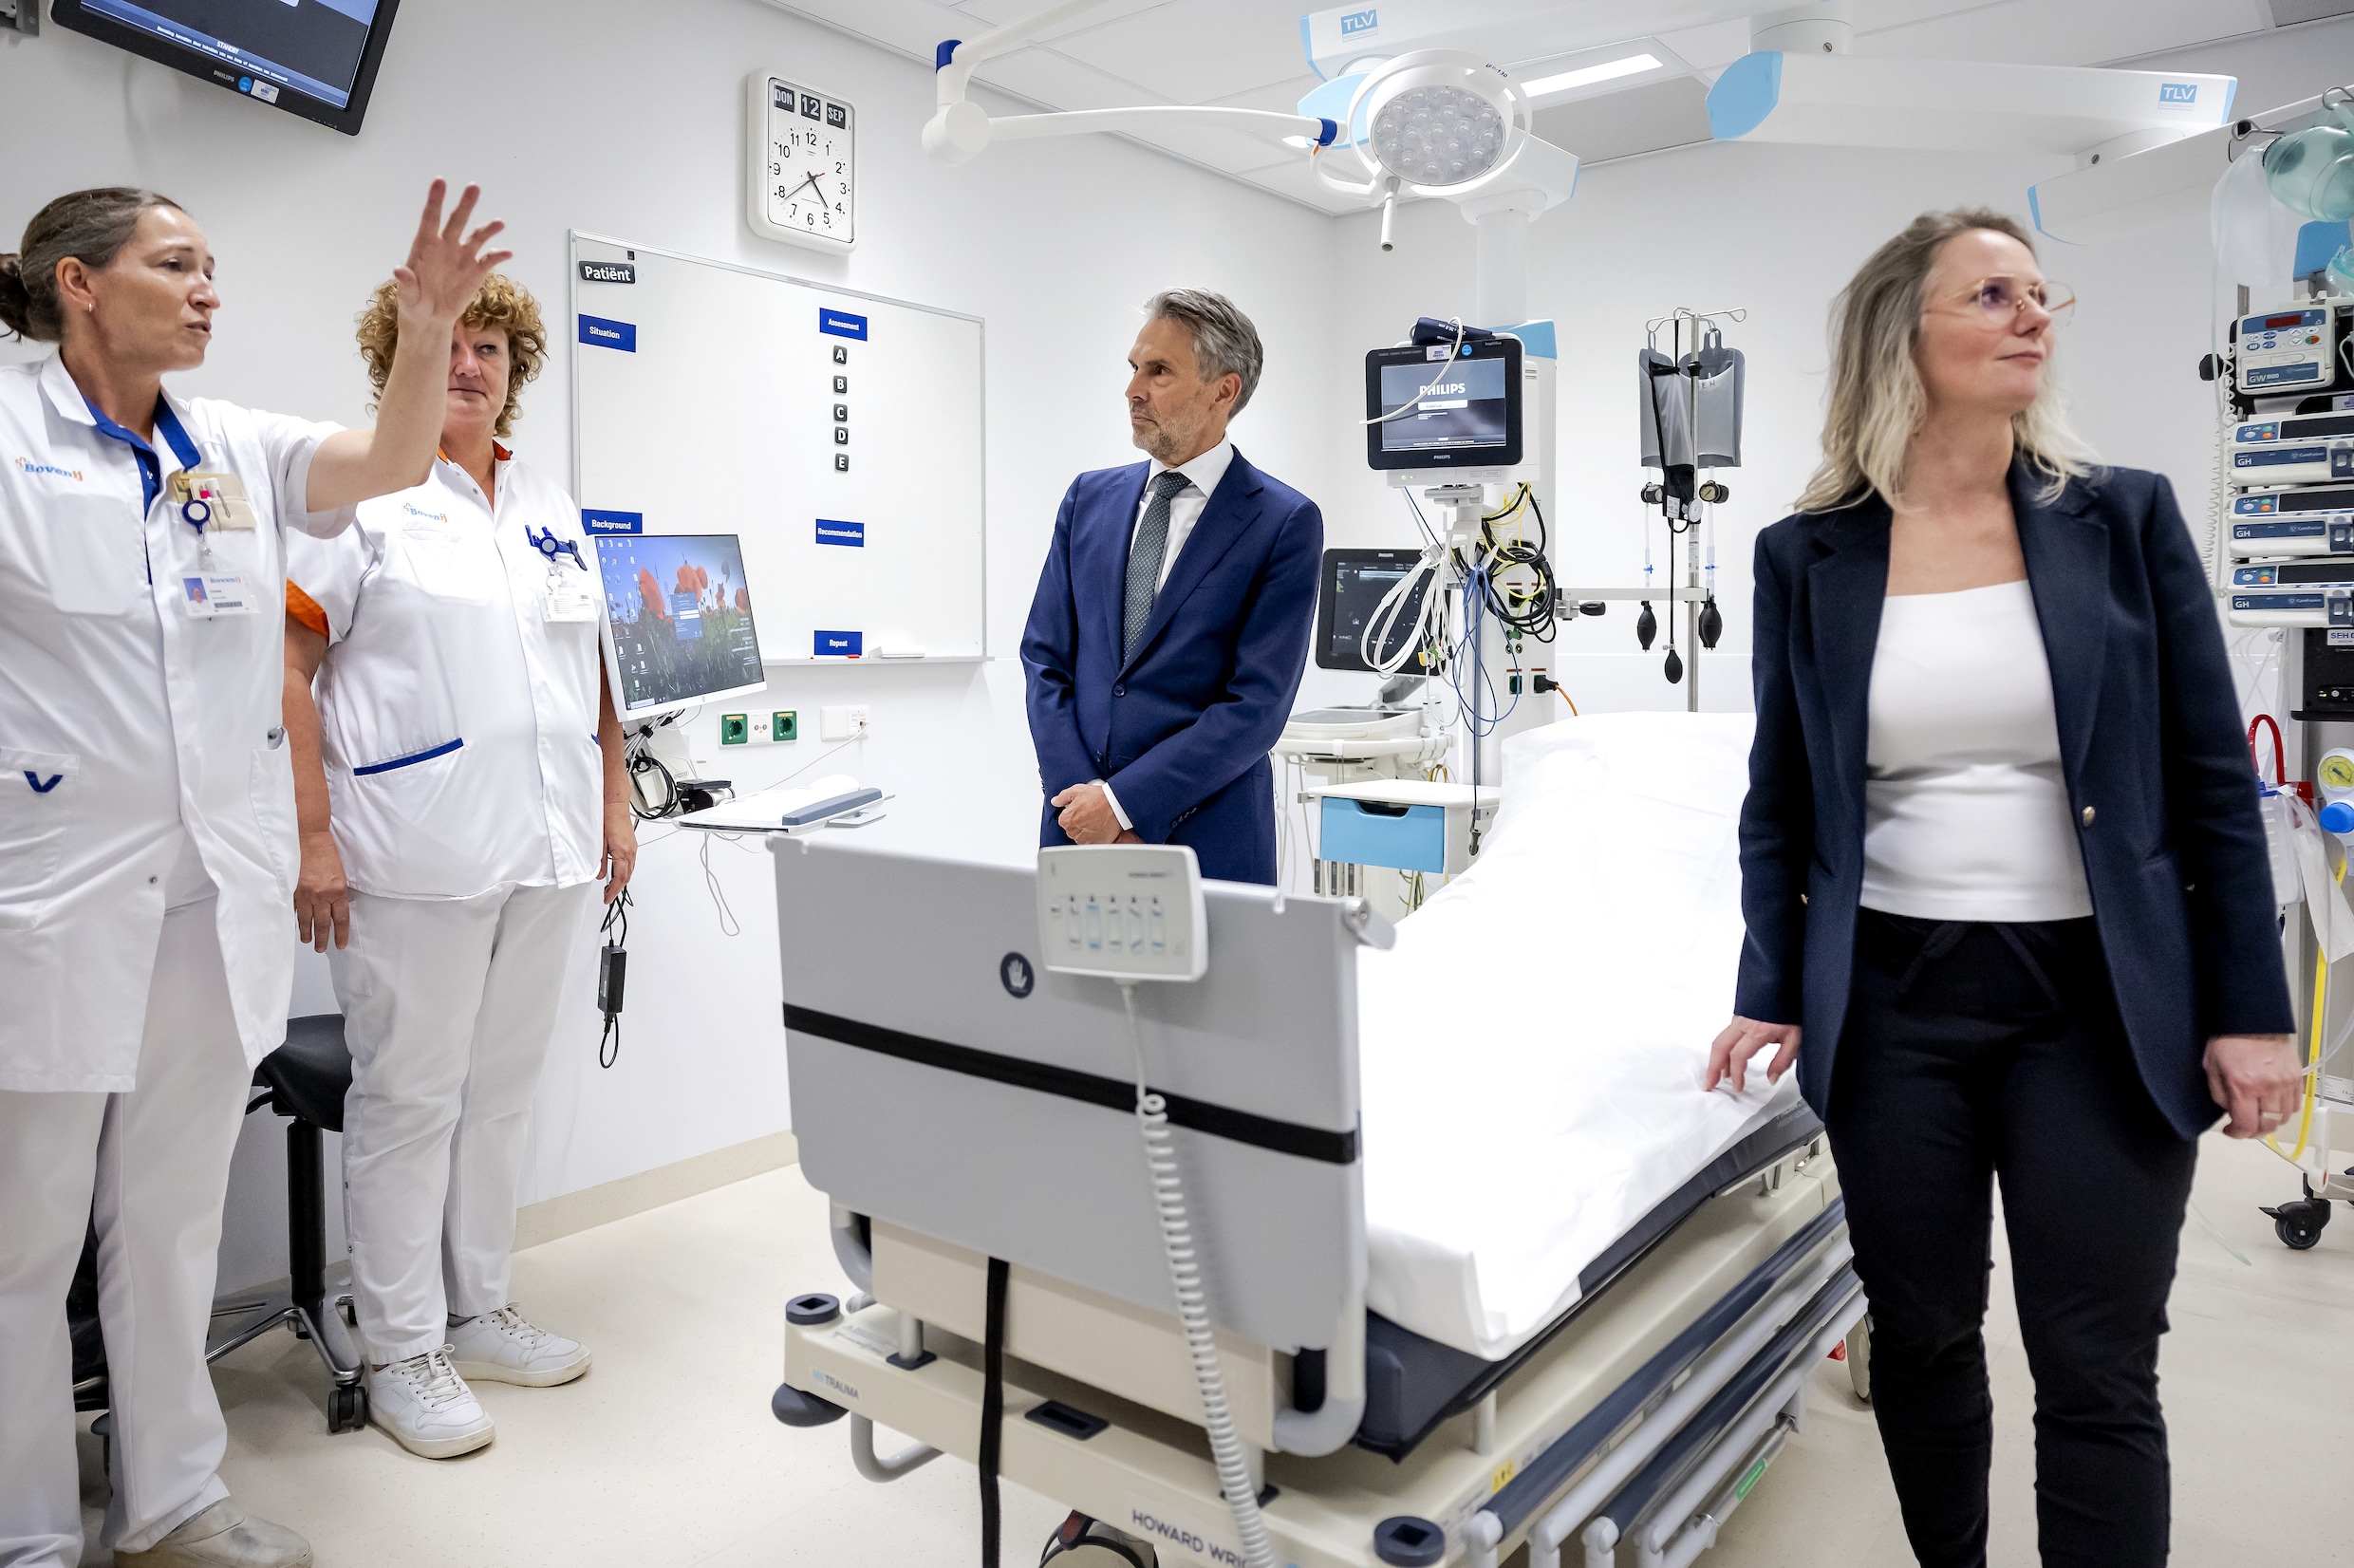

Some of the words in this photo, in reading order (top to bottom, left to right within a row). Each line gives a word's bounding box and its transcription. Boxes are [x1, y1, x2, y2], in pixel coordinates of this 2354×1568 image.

[1343, 12, 1374, 31] TLV
[213, 70, 235, 83] PHILIPS
[2163, 86, 2195, 101] TLV
[775, 88, 794, 106] DON
[801, 96, 820, 117] 12
[828, 106, 844, 122] SEP
[790, 133, 800, 146] 11
[806, 132, 817, 146] 12
[778, 144, 791, 159] 10
[825, 144, 831, 157] 1
[773, 162, 781, 176] 9
[835, 161, 842, 174] 2
[778, 185, 786, 198] 8
[839, 182, 847, 195] 3
[791, 203, 798, 215] 7
[835, 202, 843, 215] 4
[807, 213, 814, 226] 6
[823, 212, 831, 225] 5
[584, 265, 631, 282] Patiënt
[828, 318, 860, 331] Assessment
[588, 326, 621, 340] Situation
[836, 349, 845, 362] A
[837, 379, 845, 390] B
[1419, 383, 1467, 396] PHILIPS
[1698, 380, 1716, 390] EH
[836, 406, 845, 419] C
[837, 430, 847, 441] D
[838, 457, 846, 469] E
[2237, 457, 2252, 466] GH
[591, 519, 631, 531] Background
[817, 527, 863, 539] Recommendation
[2235, 530, 2251, 538] GH
[2234, 600, 2250, 608] GH
[829, 639, 848, 648] Repeat
[824, 1374, 860, 1401] TRAUMA
[1131, 1509, 1205, 1554] HOWARD
